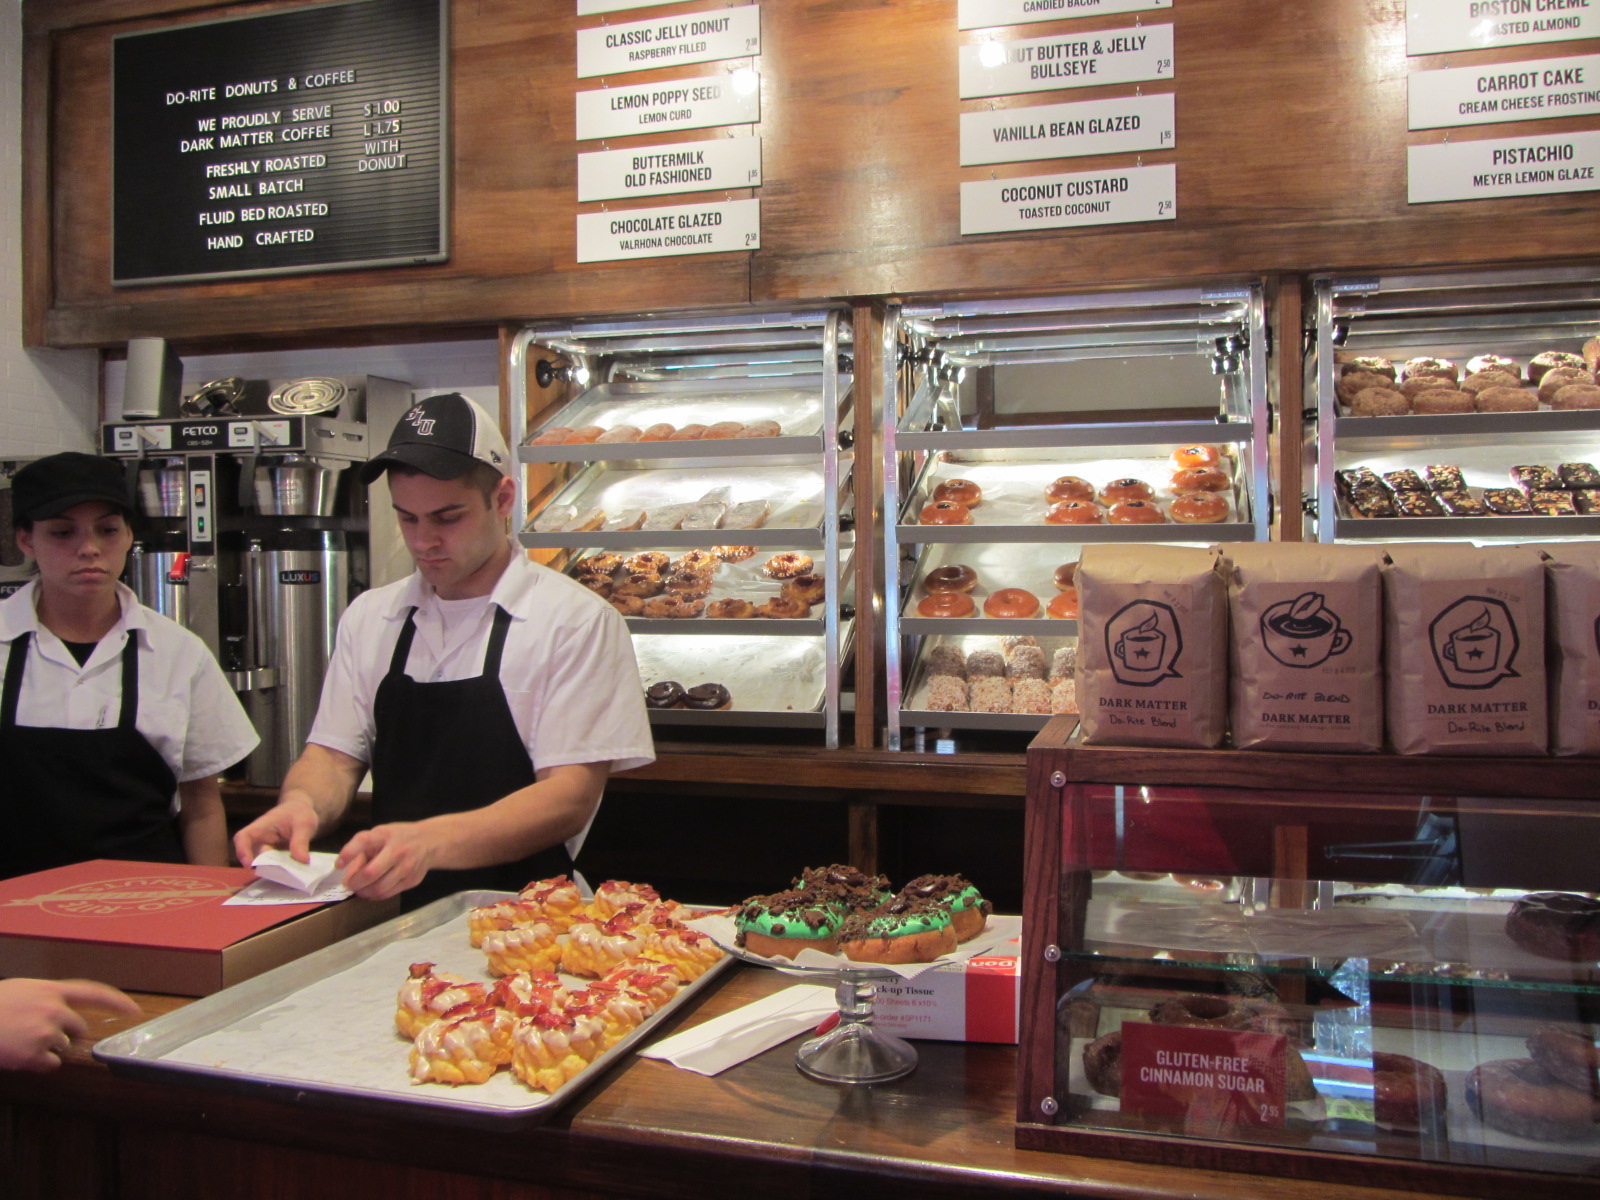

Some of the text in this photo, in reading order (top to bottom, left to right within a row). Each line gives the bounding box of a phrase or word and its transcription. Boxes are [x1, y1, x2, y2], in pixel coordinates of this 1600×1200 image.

[1023, 0, 1065, 13] CANDIED
[1470, 0, 1531, 18] BOSTON
[606, 17, 730, 48] CLASSIC JELLY DONUT
[1532, 16, 1581, 33] ALMOND
[628, 41, 706, 61] RASPBERRY FILLED
[1037, 42, 1089, 61] BUTTER
[1092, 40, 1103, 55] &
[1107, 35, 1147, 54] JELLY
[1031, 59, 1097, 80] BULLSEYE
[166, 70, 355, 105] DO-RITE DONUTS & COFFEE
[1477, 68, 1584, 93] CARROT CAKE
[611, 85, 722, 111] LEMON POPPY SEED
[1459, 100, 1498, 114] CREAM
[1501, 96, 1544, 111] CHEESE
[198, 105, 332, 132] WE PROUDLY SERVE
[364, 101, 400, 117] S 1.00
[639, 109, 692, 124] LEMON CURD
[364, 120, 400, 137] L 1.75
[993, 115, 1141, 143] VANILLA BEAN GLAZED
[180, 125, 331, 153] DARK MATTER COFFEE
[365, 140, 399, 155] WITH
[358, 155, 406, 172] DONUT
[632, 151, 704, 170] BUTTERMILK
[1493, 144, 1574, 166] PISTACHIO
[206, 154, 326, 178] FRESHLY ROASTED
[625, 167, 712, 188] OLD FASHIONED
[1473, 167, 1594, 187] MEYER LEMON GLAZE
[209, 179, 303, 200] SMALL BATCH
[1001, 177, 1129, 203] COCONUT CUSTARD
[199, 203, 328, 226] FLUID BED ROASTED
[1019, 201, 1111, 219] TOASTED COCONUT
[610, 212, 722, 235] CHOCOLATE GLAZED
[208, 229, 314, 250] HAND CRAFTED
[619, 233, 713, 250] VALRHONA CHOCOLATE
[182, 426, 218, 436] FETCO
[281, 573, 318, 582] LUXUS
[1099, 697, 1187, 711] DARK MATTER
[1428, 701, 1528, 714] DARK MATTER
[1262, 712, 1351, 724] DARK MATTER
[905, 986, 935, 995] Tissue
[1156, 1050, 1249, 1073] GLUTEN-FREE
[1140, 1066, 1265, 1093] CINNAMON SUGAR
